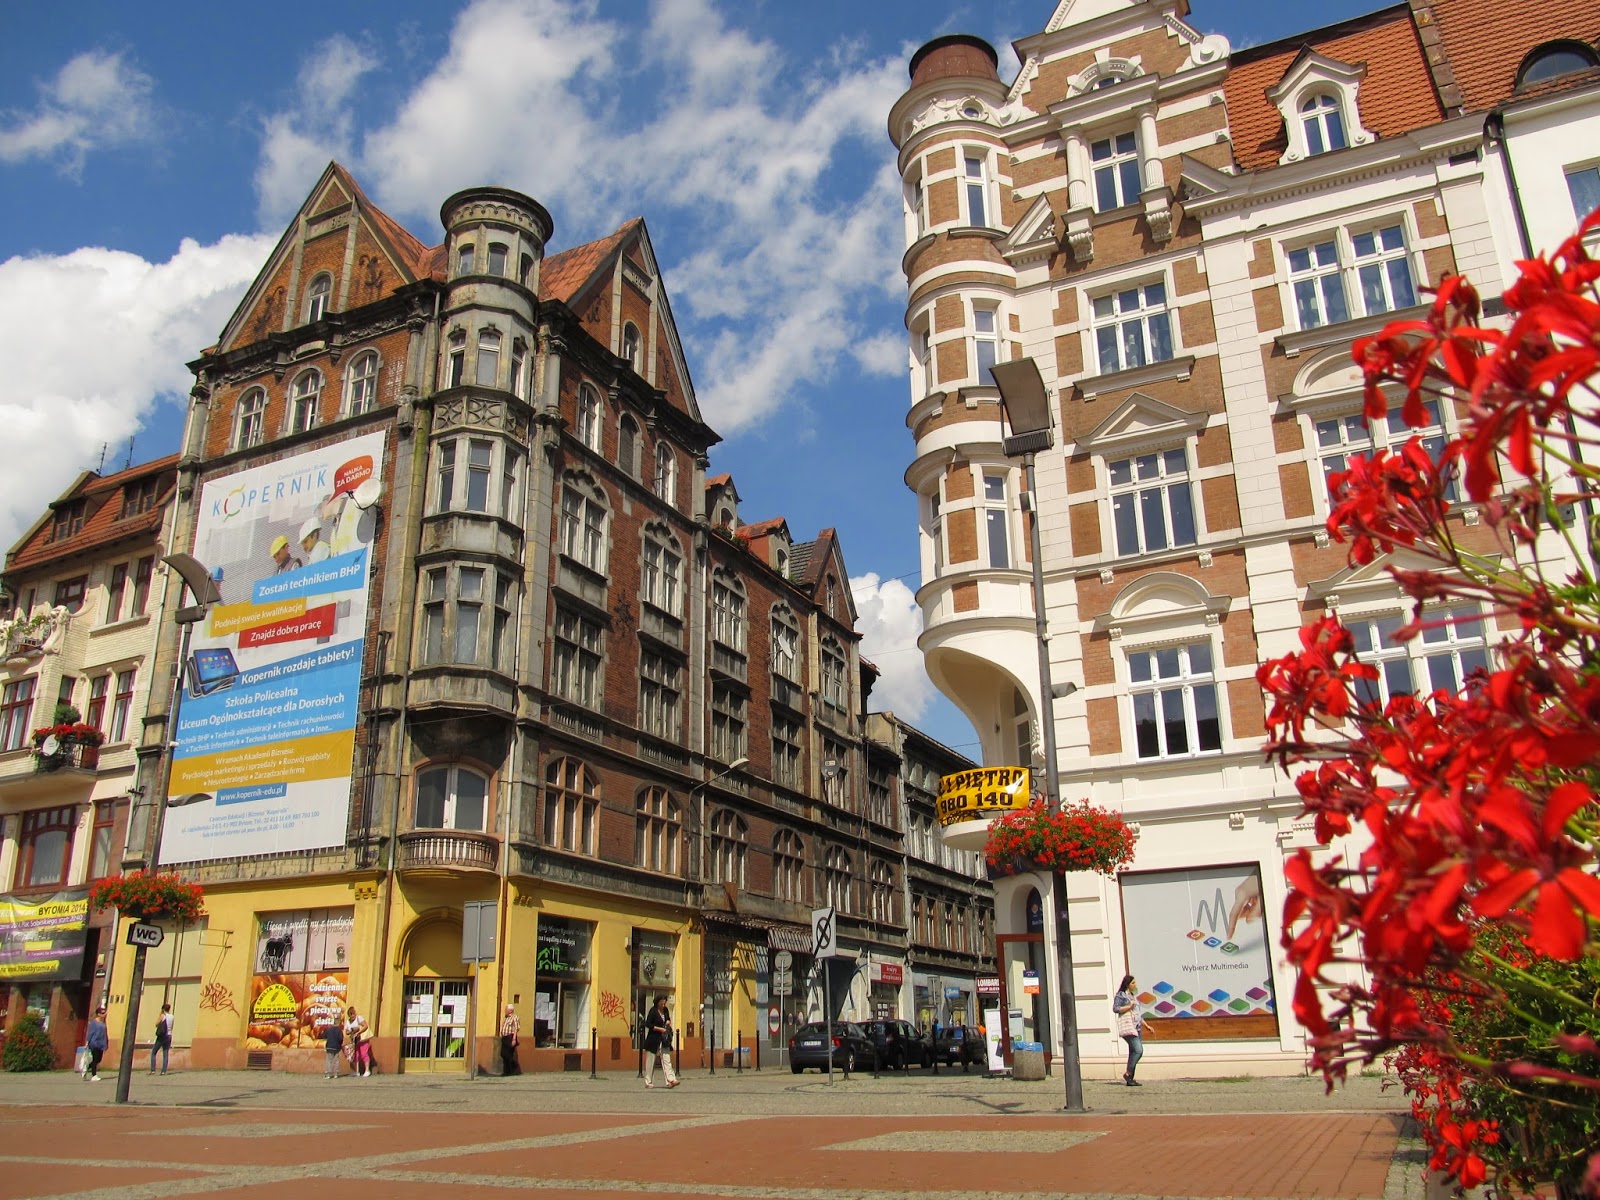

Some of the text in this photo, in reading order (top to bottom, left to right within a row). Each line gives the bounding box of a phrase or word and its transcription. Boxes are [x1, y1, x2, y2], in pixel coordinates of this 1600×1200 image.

[336, 468, 371, 488] ZA DARMO
[343, 465, 363, 477] NAUKA
[212, 469, 328, 519] KOPERNIK
[259, 563, 361, 597] Zostań technikiem BHP
[214, 602, 303, 629] Podnieś swoje kwalifikacje
[250, 620, 322, 642] Znajdź dobrą pracę
[241, 646, 355, 685] Kopernik rozdaje tablety!
[225, 687, 299, 708] Szkoła Policealna
[180, 692, 345, 731] Liceum Ogólnokształcące dla Dorosłych
[215, 728, 236, 739] Technik
[277, 718, 300, 729] Technik
[955, 768, 1024, 791] PIĘTRO
[220, 784, 284, 802] www.kopernik-edu.pl
[940, 791, 1014, 815] 980 140
[38, 905, 70, 915] BYTOMIA
[136, 927, 157, 941] WC
[1181, 961, 1250, 974] Wybierz Multimedia
[257, 987, 274, 1006] EMILIA
[309, 983, 347, 992] Codziennie
[310, 1005, 342, 1016] pieczywo
